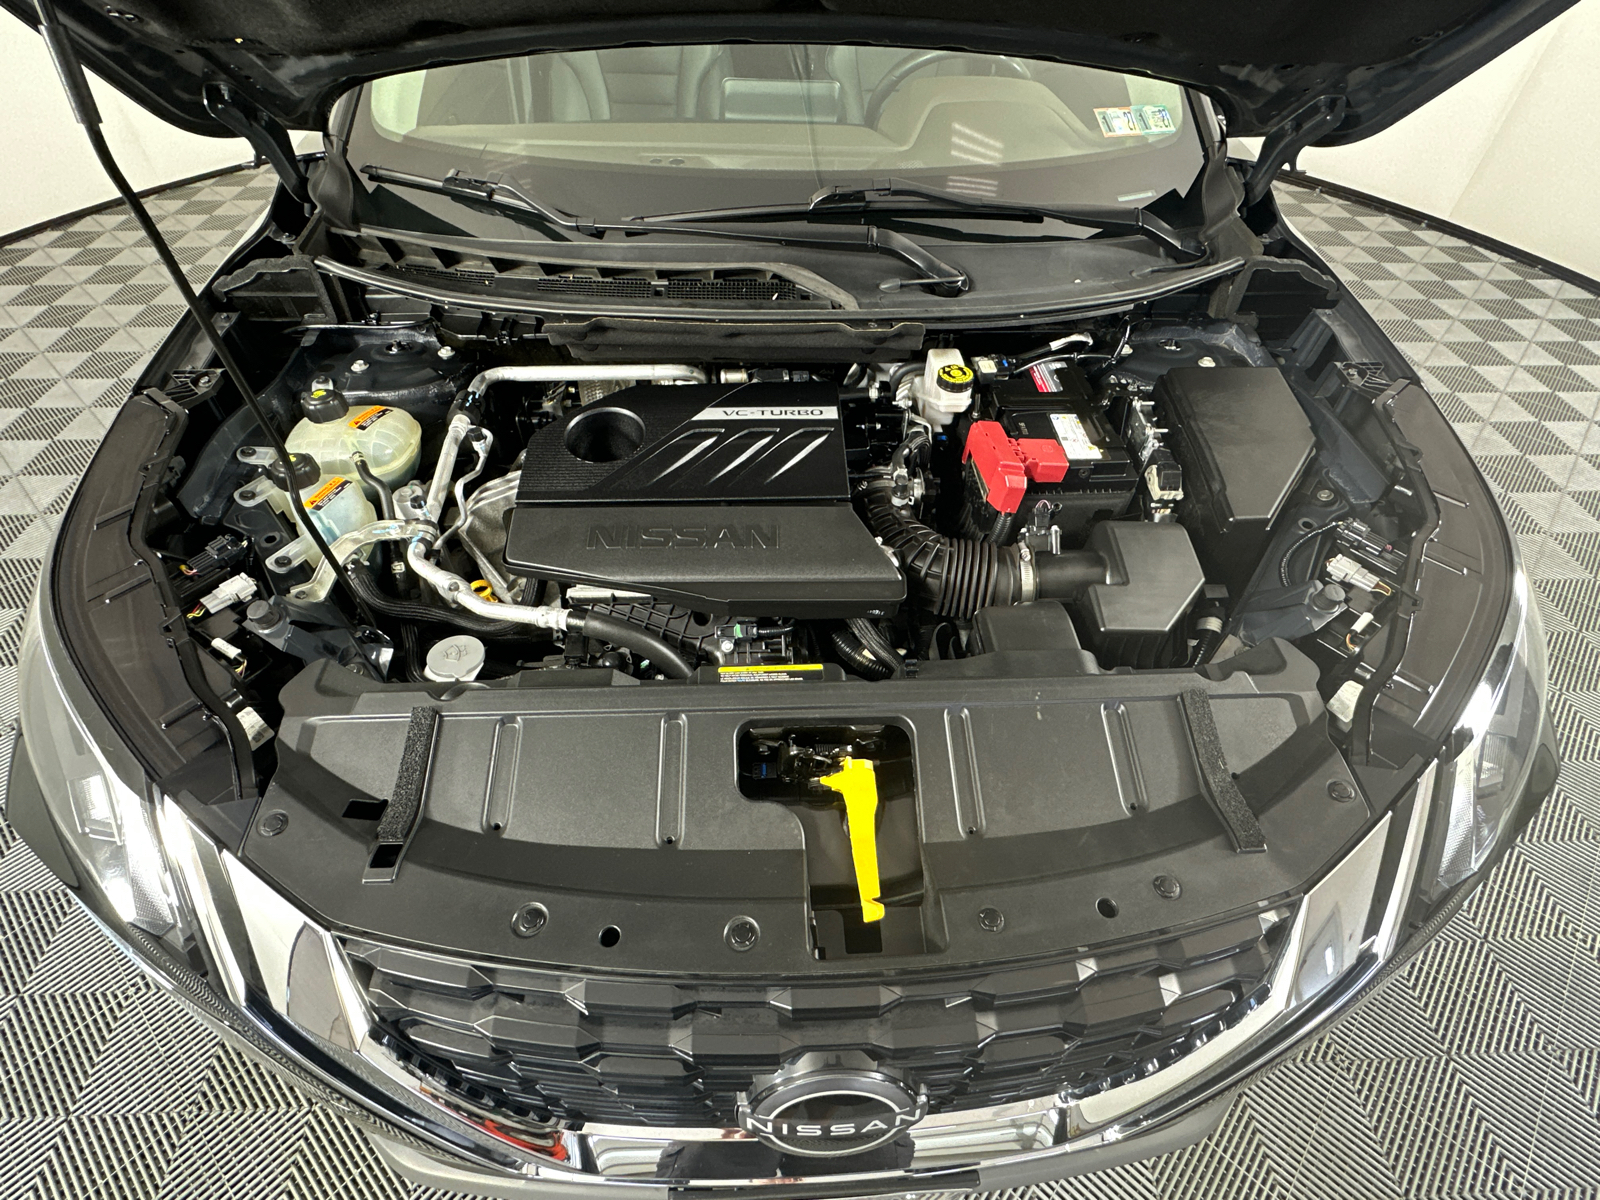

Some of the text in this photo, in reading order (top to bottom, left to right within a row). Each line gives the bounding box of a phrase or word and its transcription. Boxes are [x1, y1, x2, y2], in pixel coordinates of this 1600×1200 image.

[722, 408, 824, 417] VC-TURBO
[586, 524, 780, 549] NISSAN
[746, 1107, 921, 1136] NISSAN
